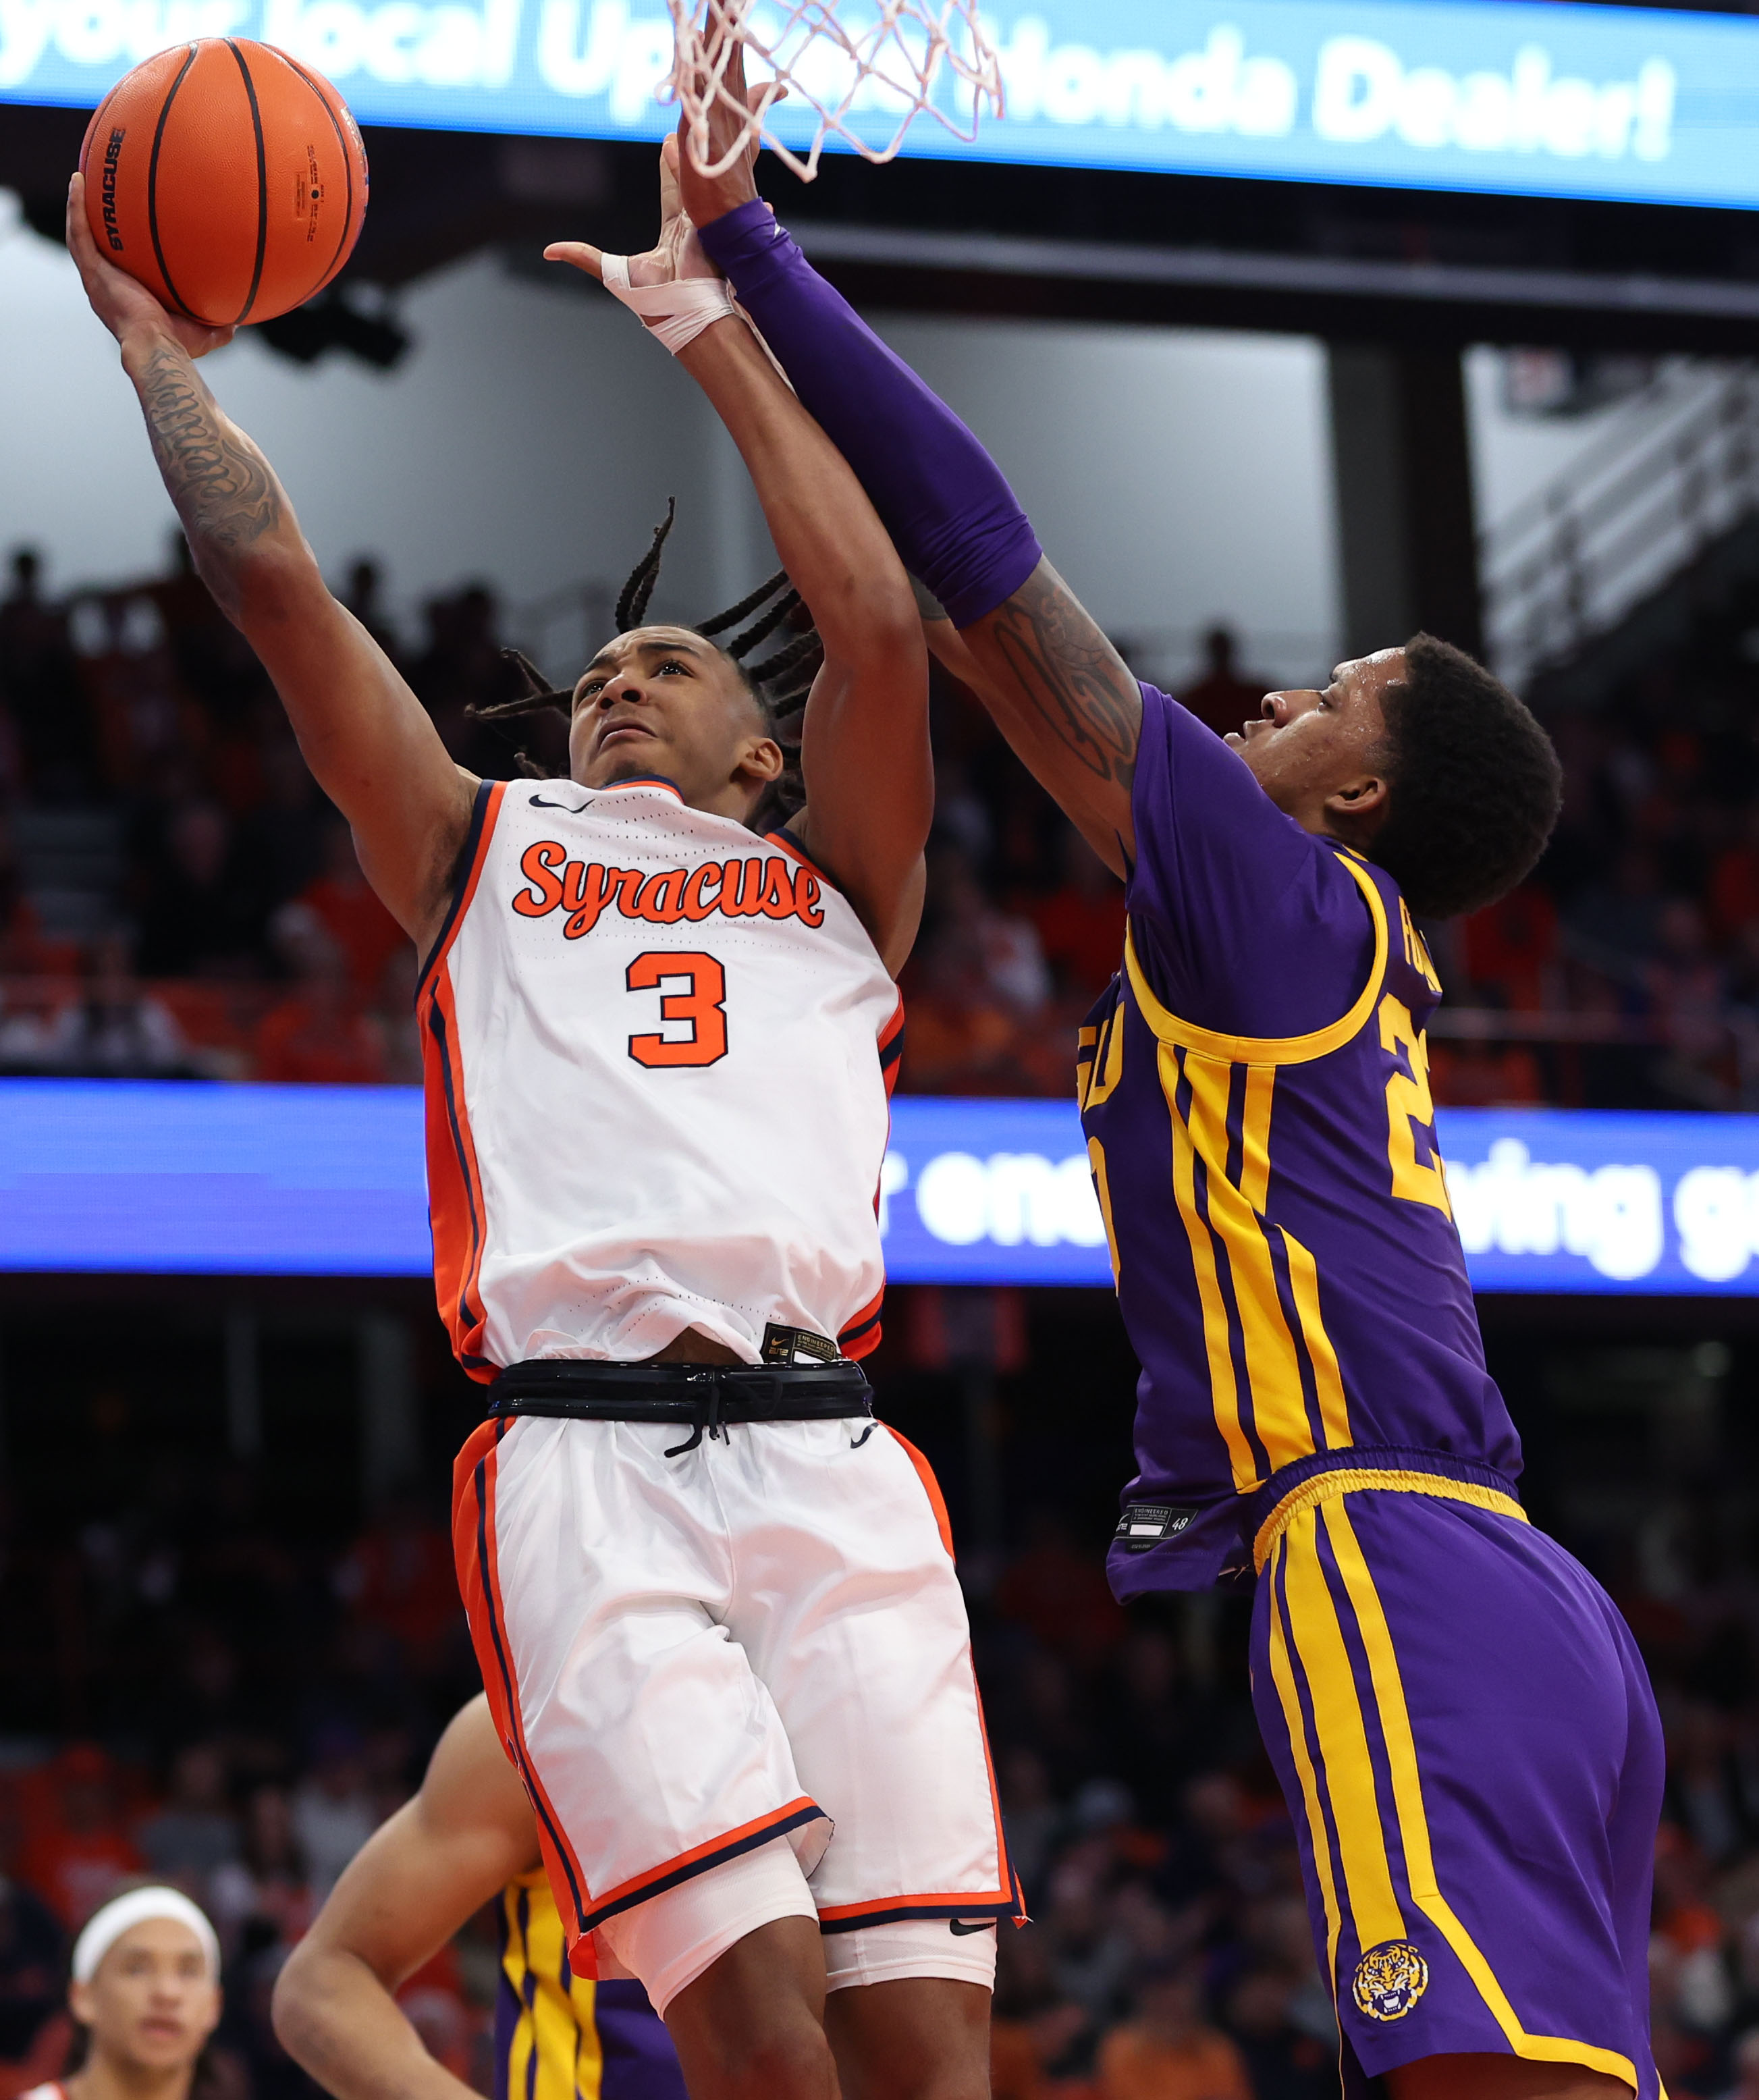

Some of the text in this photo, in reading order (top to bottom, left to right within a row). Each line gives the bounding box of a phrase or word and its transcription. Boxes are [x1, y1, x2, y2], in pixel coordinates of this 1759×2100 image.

[262, 0, 518, 88] local
[953, 17, 1295, 136] Honda
[1313, 35, 1674, 161] Dealer!
[101, 128, 126, 252] SYRACUSE
[512, 840, 825, 940] Syracuse
[626, 951, 728, 1069] 3
[797, 1335, 835, 1353] ENGINEERED
[1135, 1507, 1168, 1515] ENGINEERED
[1172, 1517, 1189, 1531] 48
